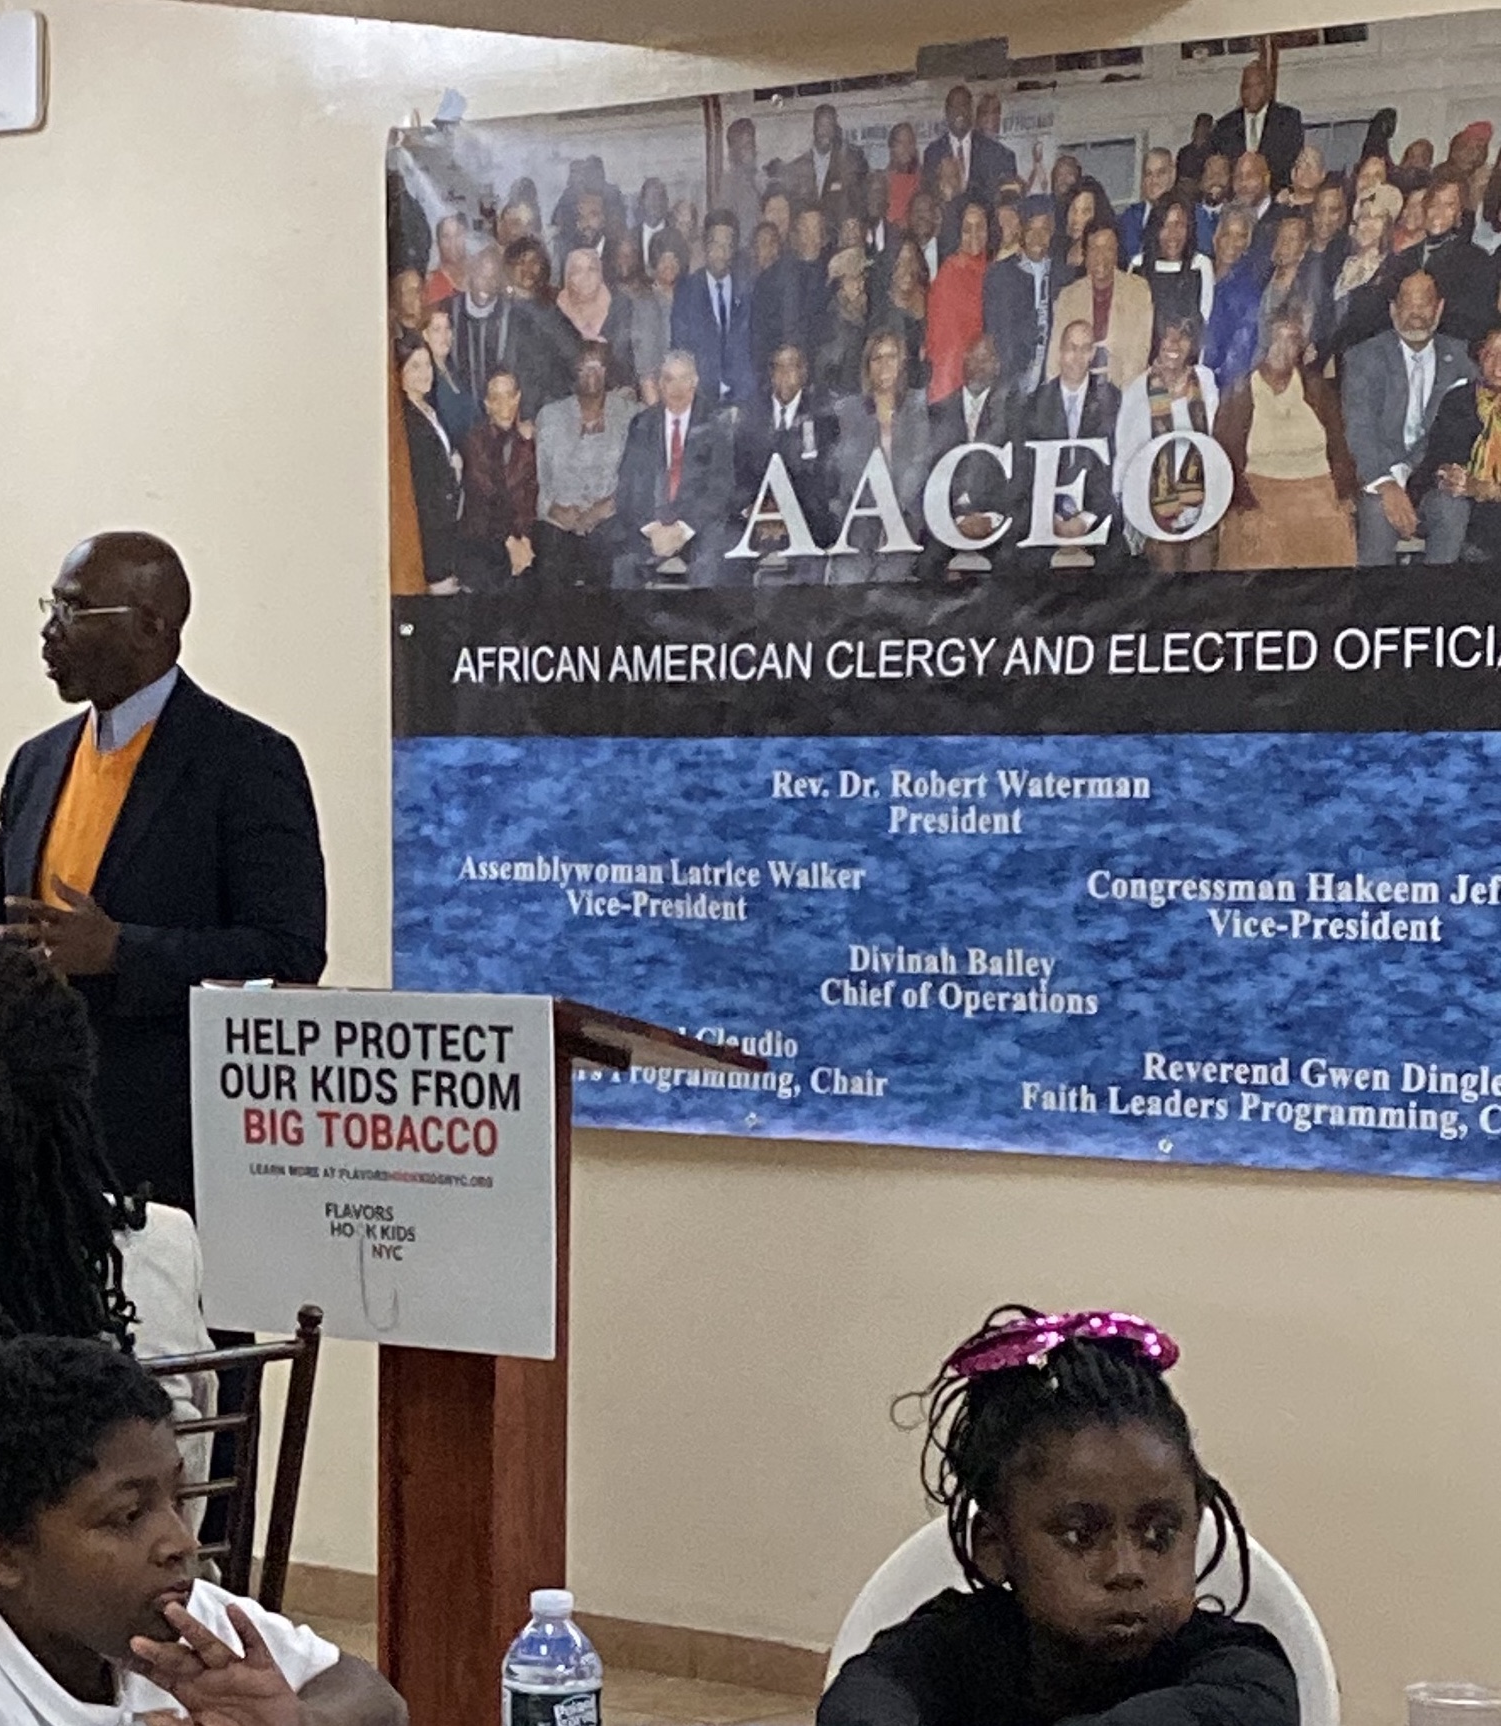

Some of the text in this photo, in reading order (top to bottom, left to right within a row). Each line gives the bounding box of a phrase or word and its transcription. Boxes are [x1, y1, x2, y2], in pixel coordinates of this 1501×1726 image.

[723, 430, 1235, 560] AACEO
[452, 624, 1501, 683] AFRICAN AMERICAN CLERGY AND ELECTED OFFICI
[770, 769, 1151, 800] Rev. Dr. Robert Waterman
[889, 806, 1022, 837] President
[459, 856, 867, 891] Assemblywoman Latrice Walker
[1087, 870, 1296, 908] Congressman
[1307, 873, 1440, 905] Hakeem
[565, 889, 749, 922] Vice-President
[1208, 909, 1445, 944] Vice-President
[848, 944, 1057, 981] Divinah Bailey
[819, 980, 1099, 1017] Chief of Operations
[224, 1016, 514, 1063] HELP PROTECT
[219, 1061, 523, 1113] OUR KIDS FROM
[610, 1064, 801, 1099] rogramming,
[809, 1066, 889, 1098] Chair
[1142, 1052, 1290, 1087] Reverend
[1300, 1057, 1391, 1093] Gwen
[1020, 1081, 1098, 1114] Faith
[1107, 1086, 1229, 1121] Leaders
[1238, 1092, 1470, 1141] Programming,
[243, 1108, 499, 1156] BIG TOBACCO
[325, 1202, 394, 1222] FLAVORS
[371, 1243, 404, 1262] NYC
[380, 1225, 417, 1243] KIDS
